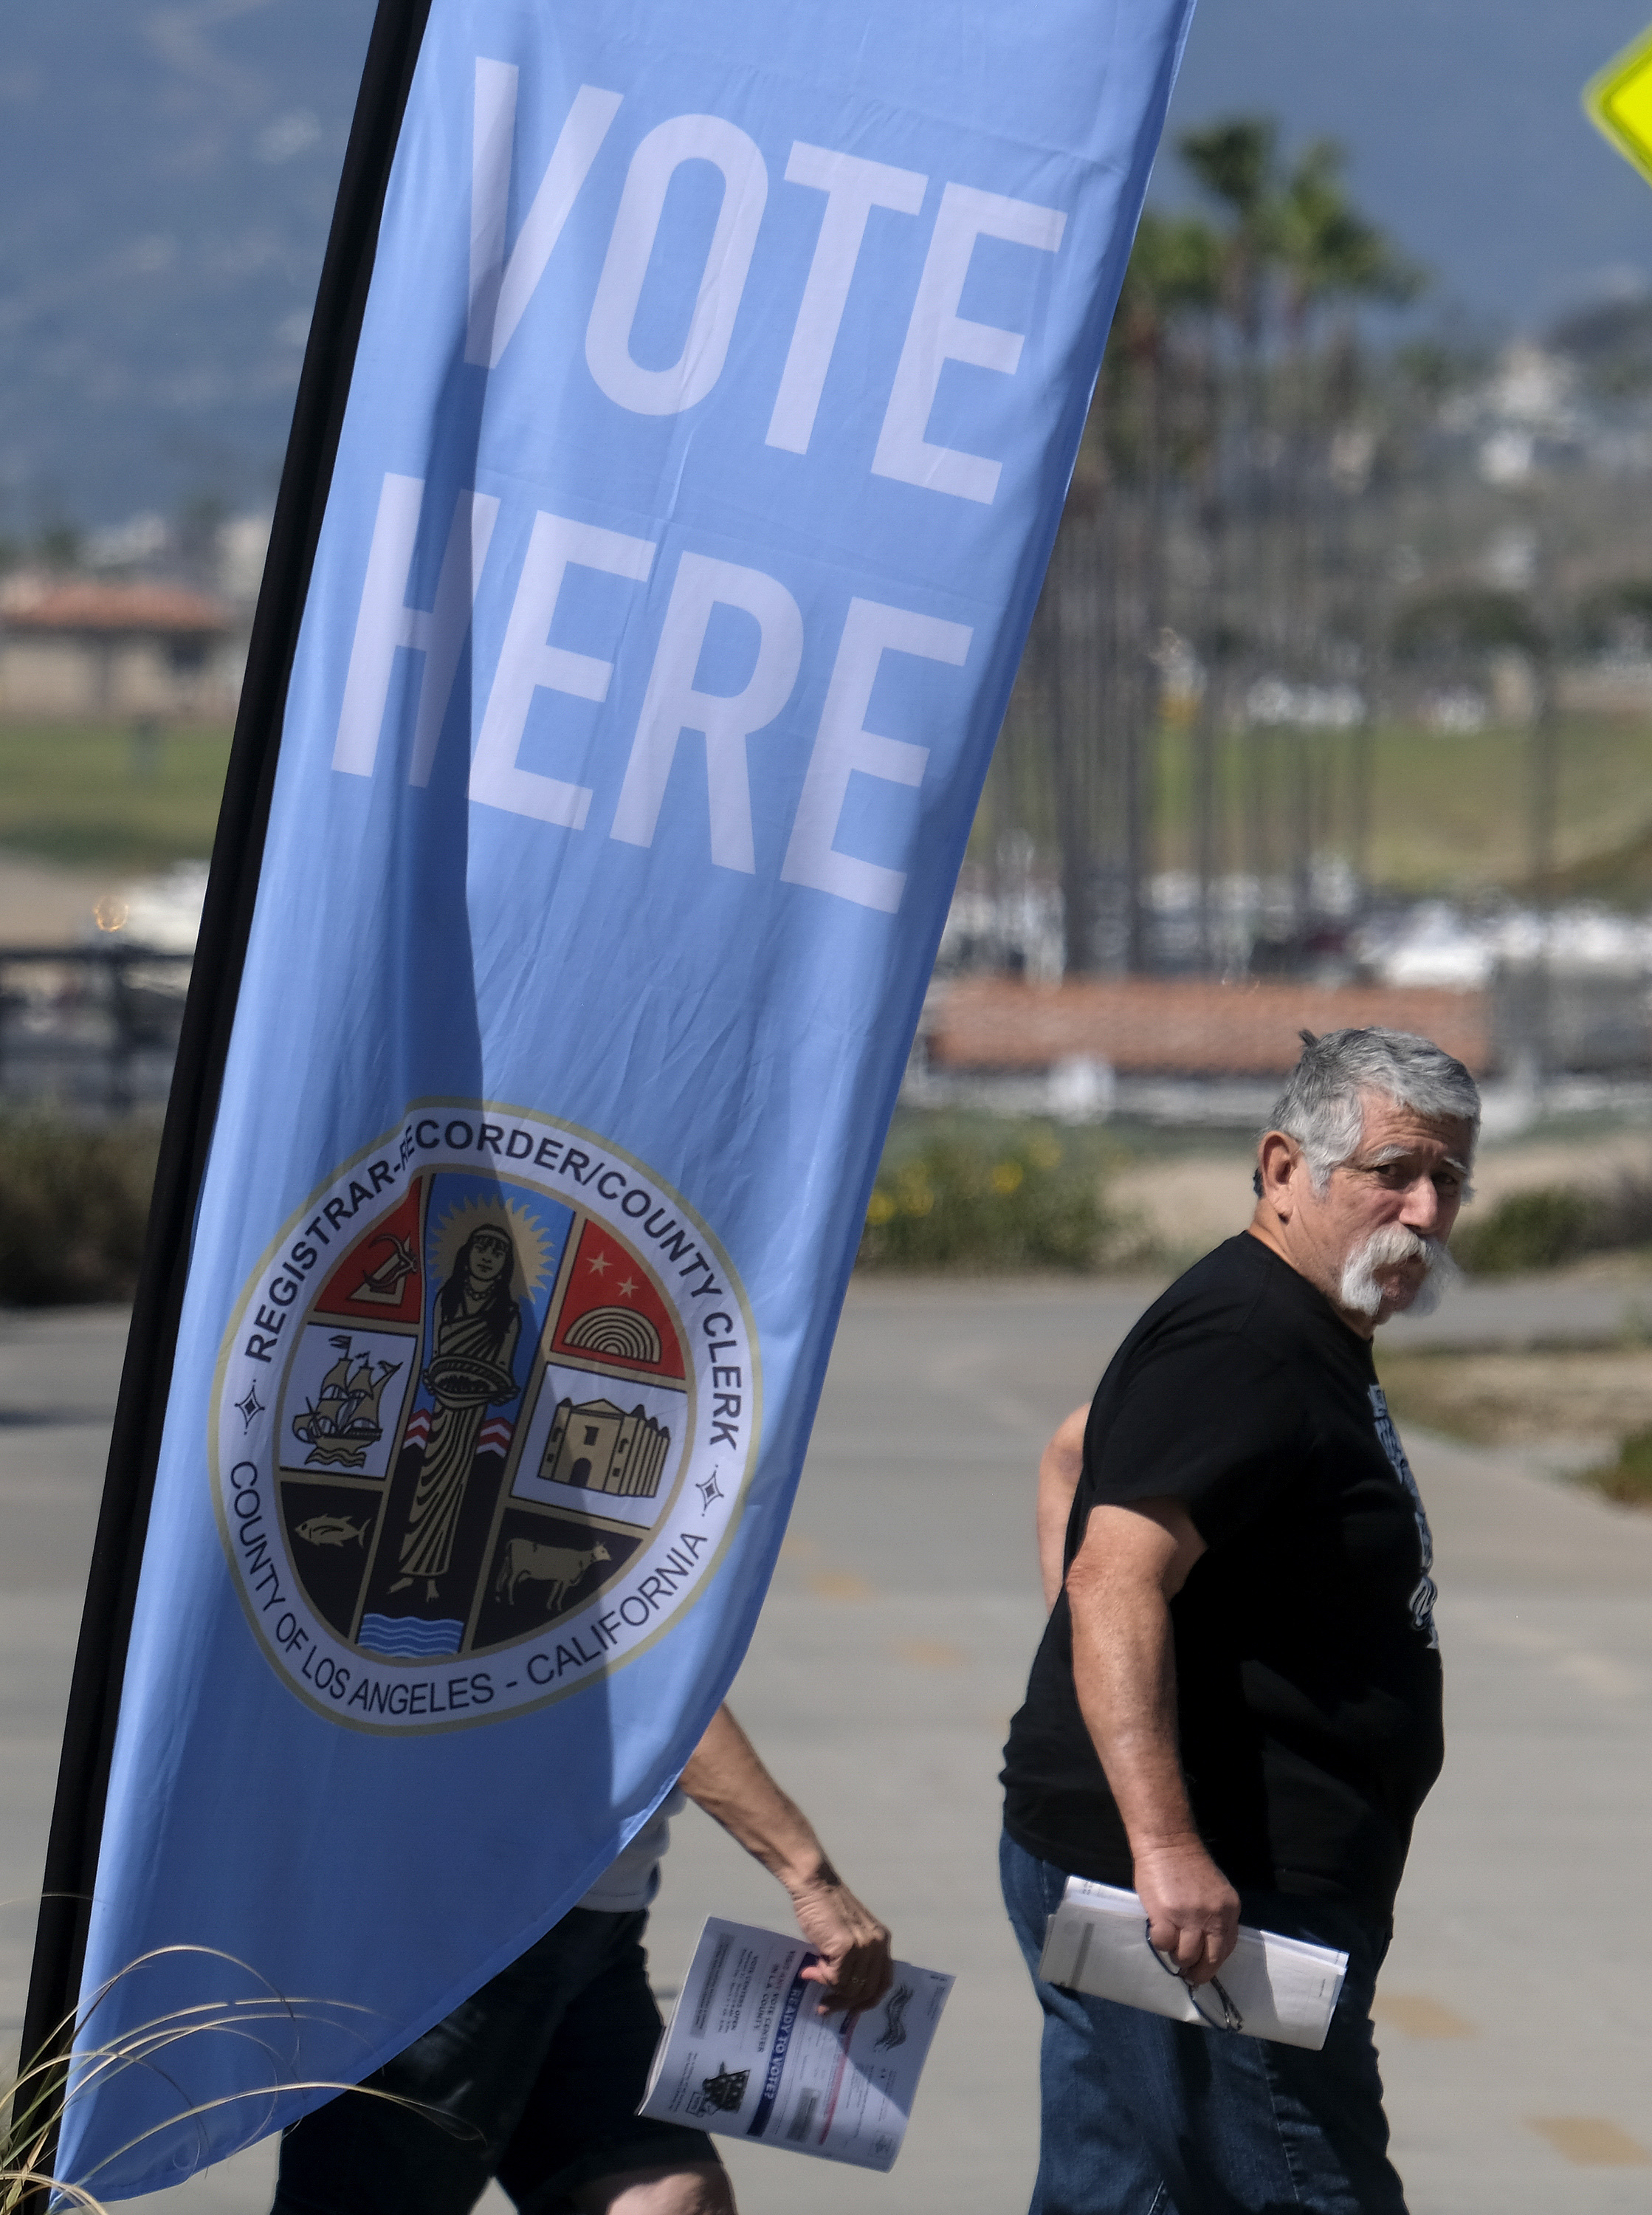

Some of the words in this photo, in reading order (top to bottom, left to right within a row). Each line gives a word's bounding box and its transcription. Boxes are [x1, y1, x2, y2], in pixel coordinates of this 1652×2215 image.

[464, 56, 1067, 505] VOTE
[331, 472, 974, 914] HERE
[701, 1311, 741, 1450] CLERK
[230, 1461, 286, 1611] COUNTY
[276, 1613, 309, 1653] OF
[302, 1646, 351, 1699] LOS
[348, 1673, 495, 1715] ANGELES
[526, 1533, 708, 1685] CALIFORNIA
[763, 2056, 782, 2100] VOTE?
[774, 2036, 788, 2054] TO
[779, 1989, 801, 2033] READY
